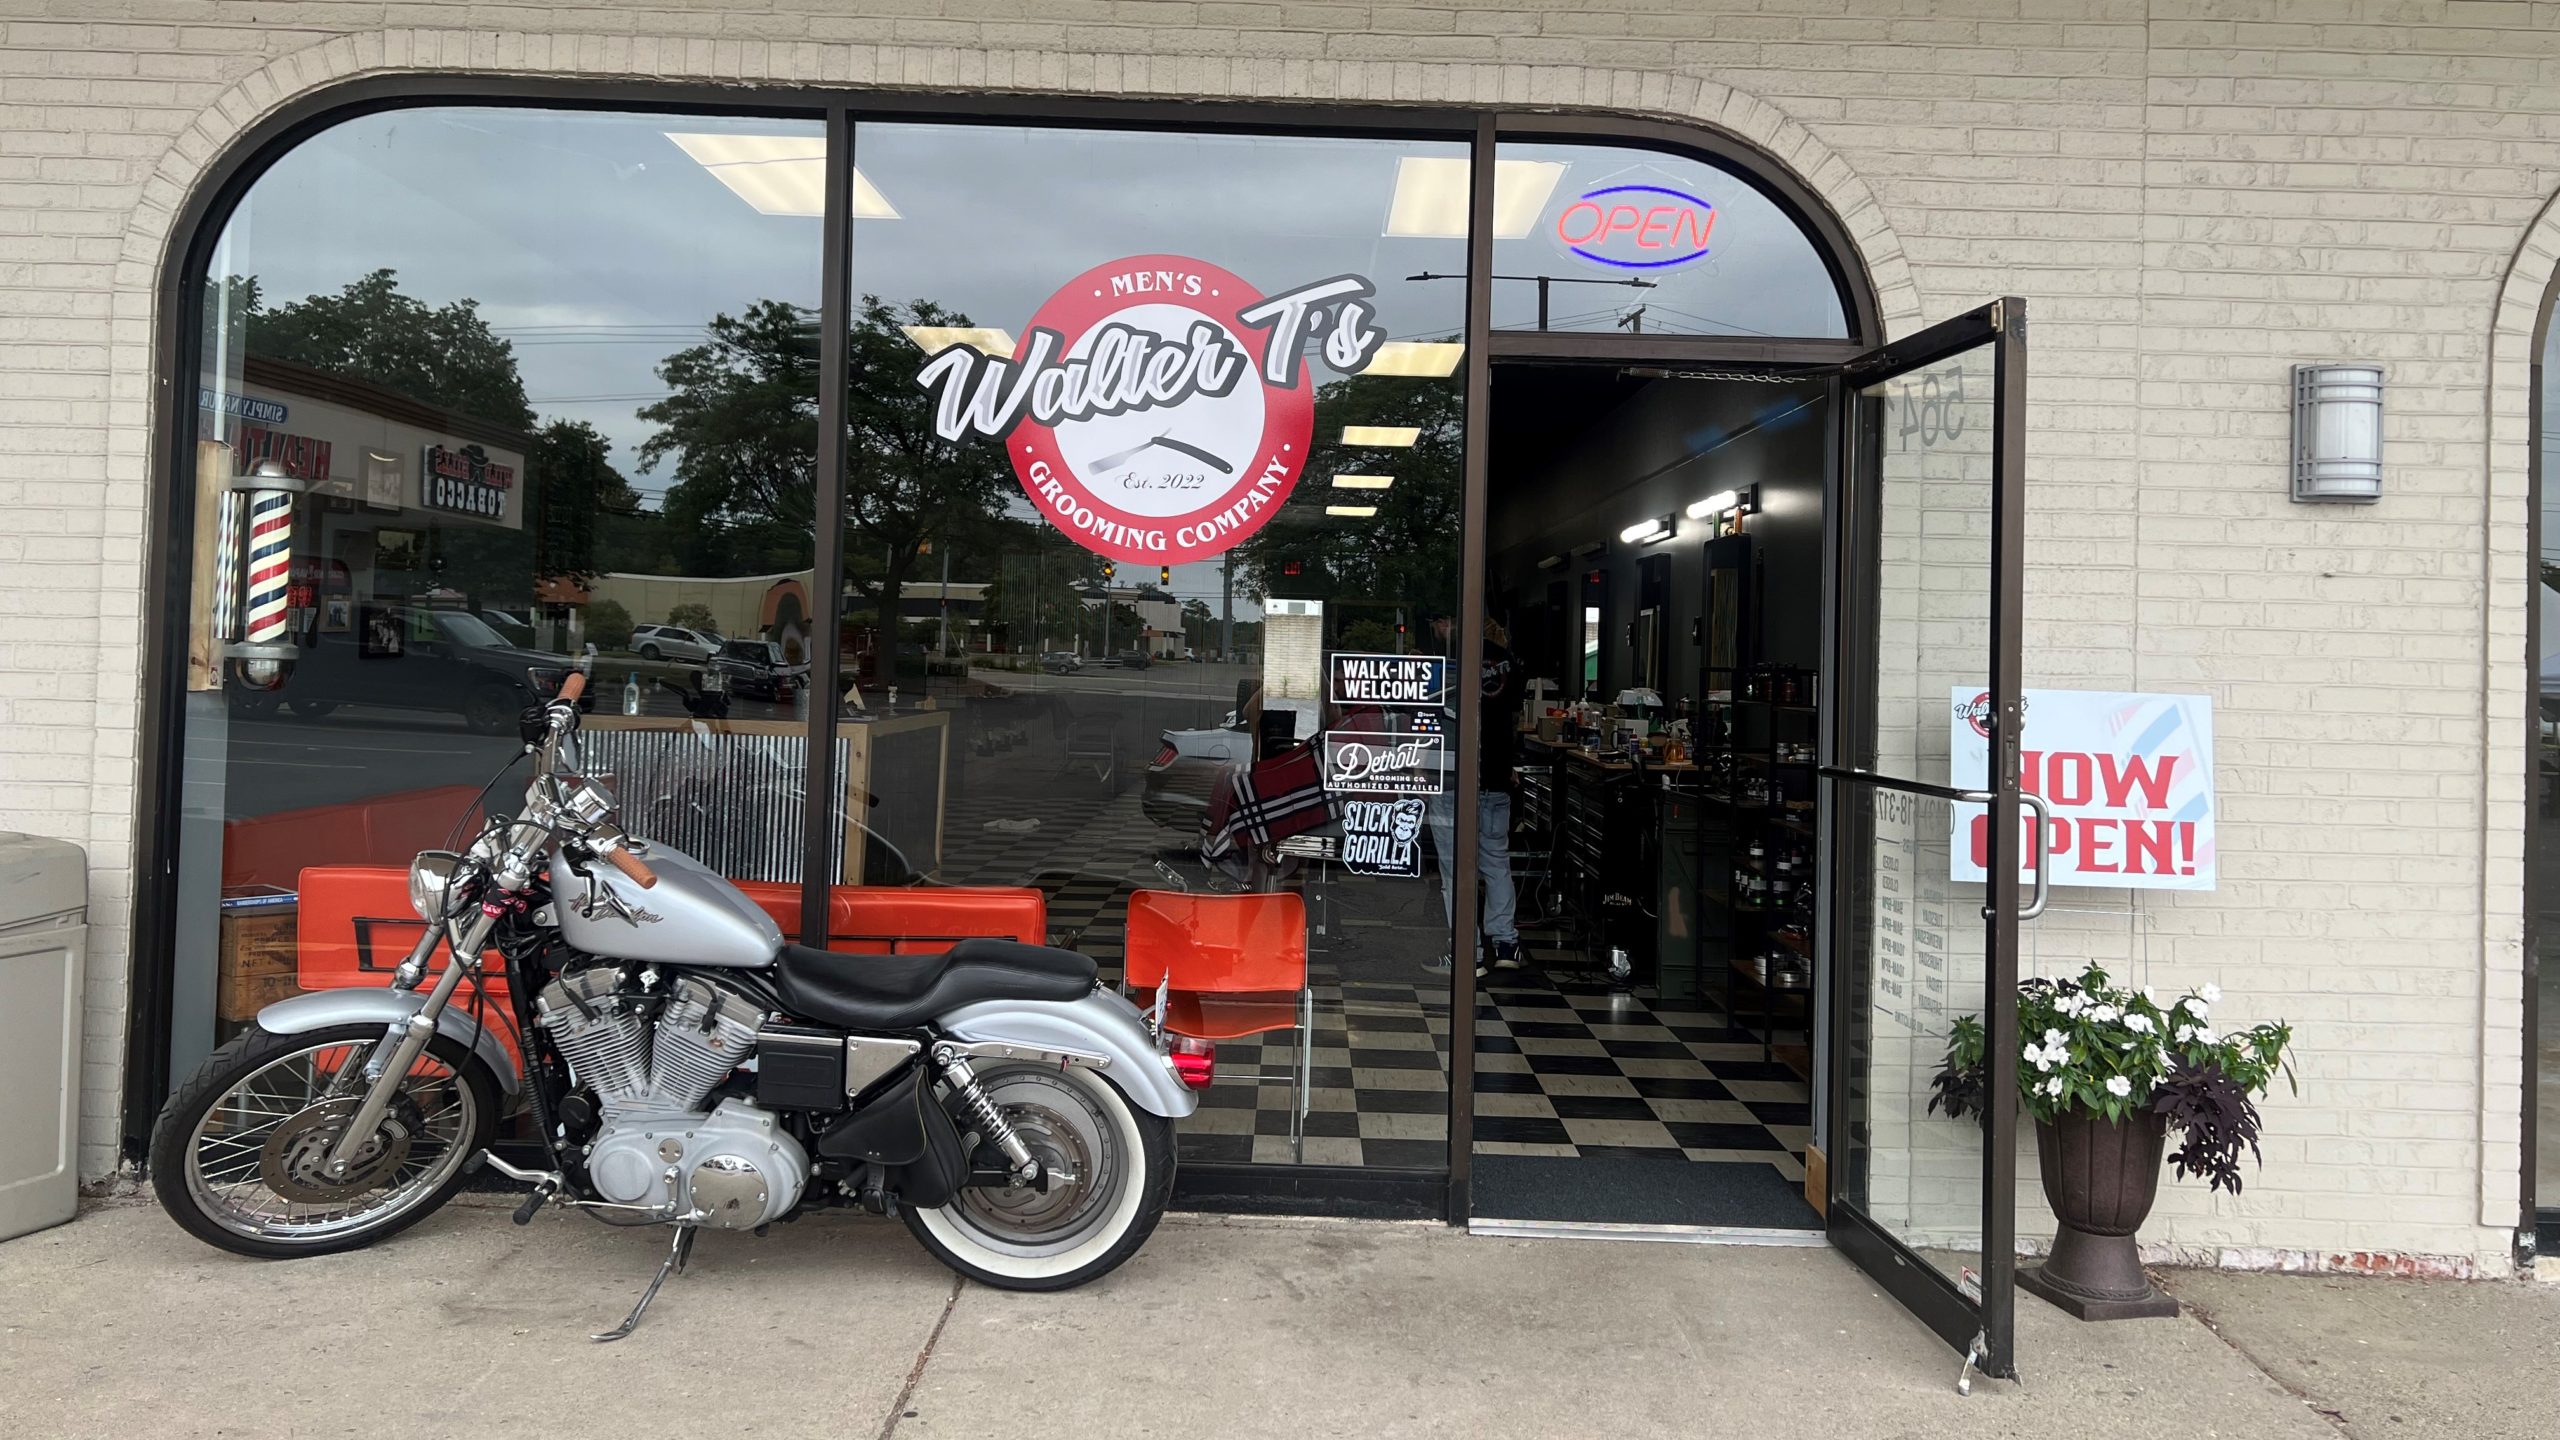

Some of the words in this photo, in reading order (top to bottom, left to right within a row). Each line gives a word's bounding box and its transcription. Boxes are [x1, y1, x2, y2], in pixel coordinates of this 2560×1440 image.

[1557, 201, 1718, 249] OPEN
[1110, 270, 1202, 297] MEN'S
[915, 322, 1244, 441] Walter
[1239, 275, 1382, 387] T's
[1121, 472, 1153, 490] Est.
[1157, 472, 1205, 490] 2022
[1029, 460, 1168, 551] GROOMING
[1176, 455, 1290, 549] COMPANY
[1342, 660, 1432, 680] WALK-IN'S
[1344, 680, 1429, 700] WELCOME
[1332, 738, 1434, 781] Detroit
[1328, 782, 1390, 790] AUTHORIZED
[1394, 784, 1439, 792] RETAILER
[1344, 802, 1391, 833] SLICK
[1344, 834, 1411, 866] GORILLA
